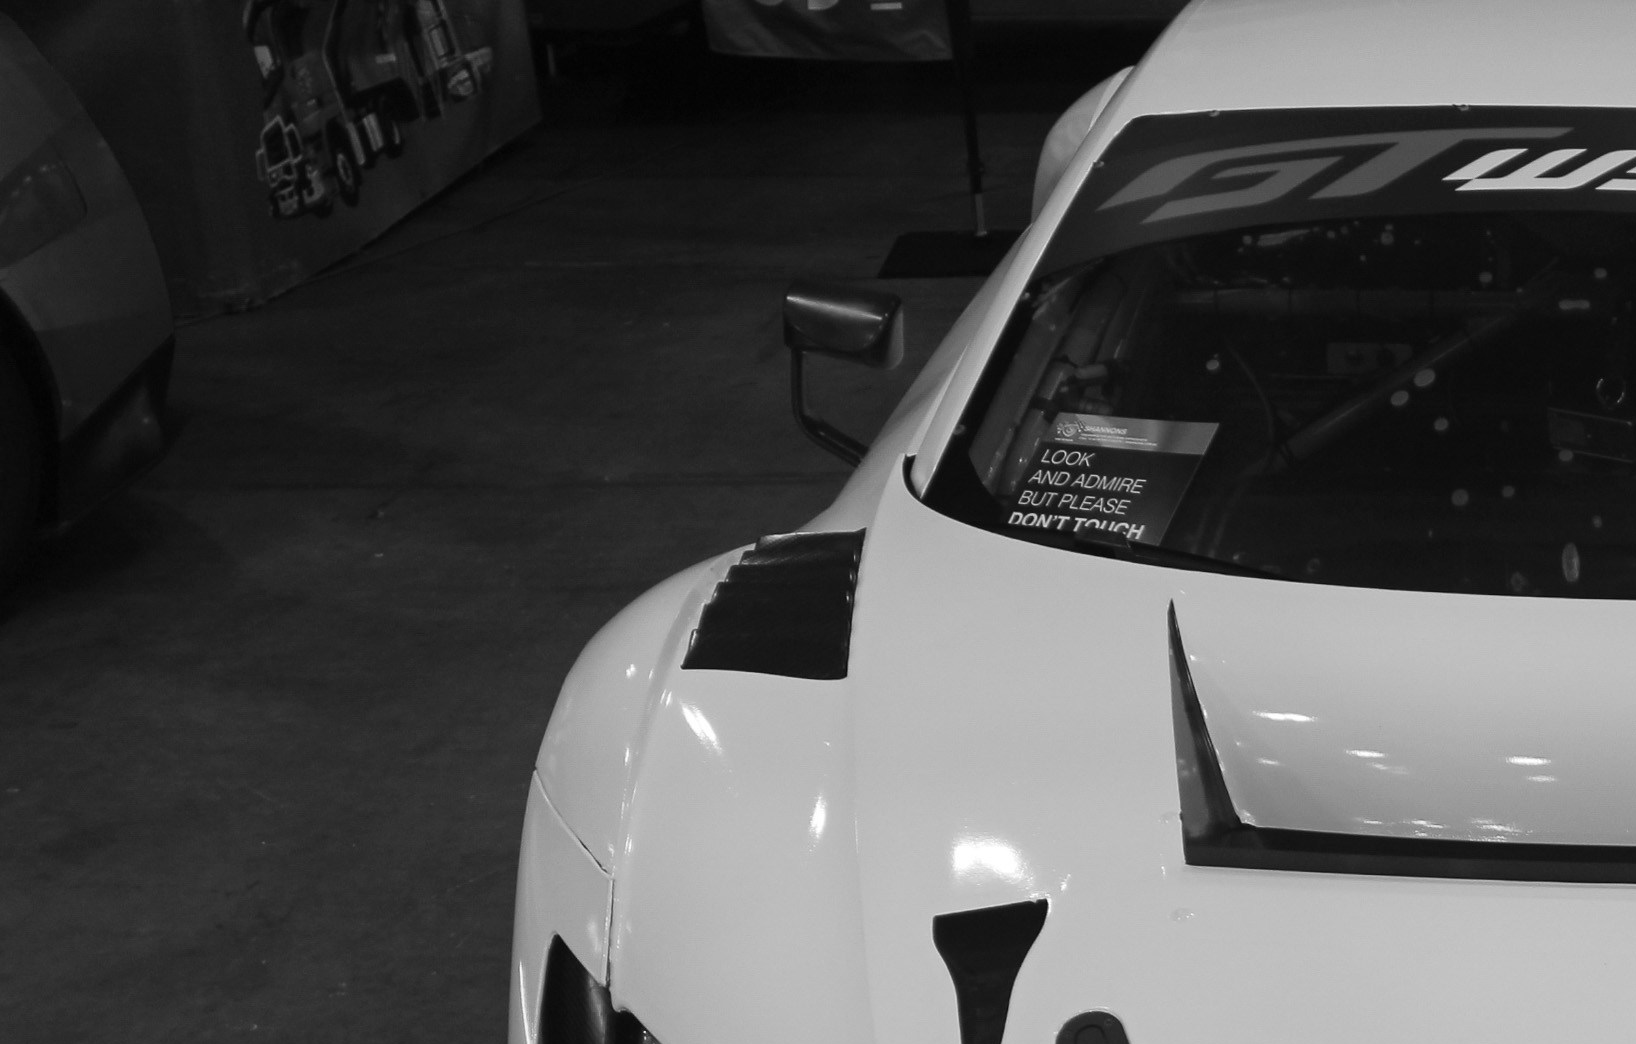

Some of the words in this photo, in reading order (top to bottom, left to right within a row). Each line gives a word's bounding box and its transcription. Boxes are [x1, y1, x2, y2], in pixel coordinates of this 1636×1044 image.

[1041, 448, 1096, 467] LOOK
[1028, 469, 1071, 486] AND
[1071, 473, 1147, 494] ADMIRE
[1017, 490, 1058, 506] BUT
[1058, 493, 1131, 515] PLEASE
[1008, 511, 1070, 530] DON'T
